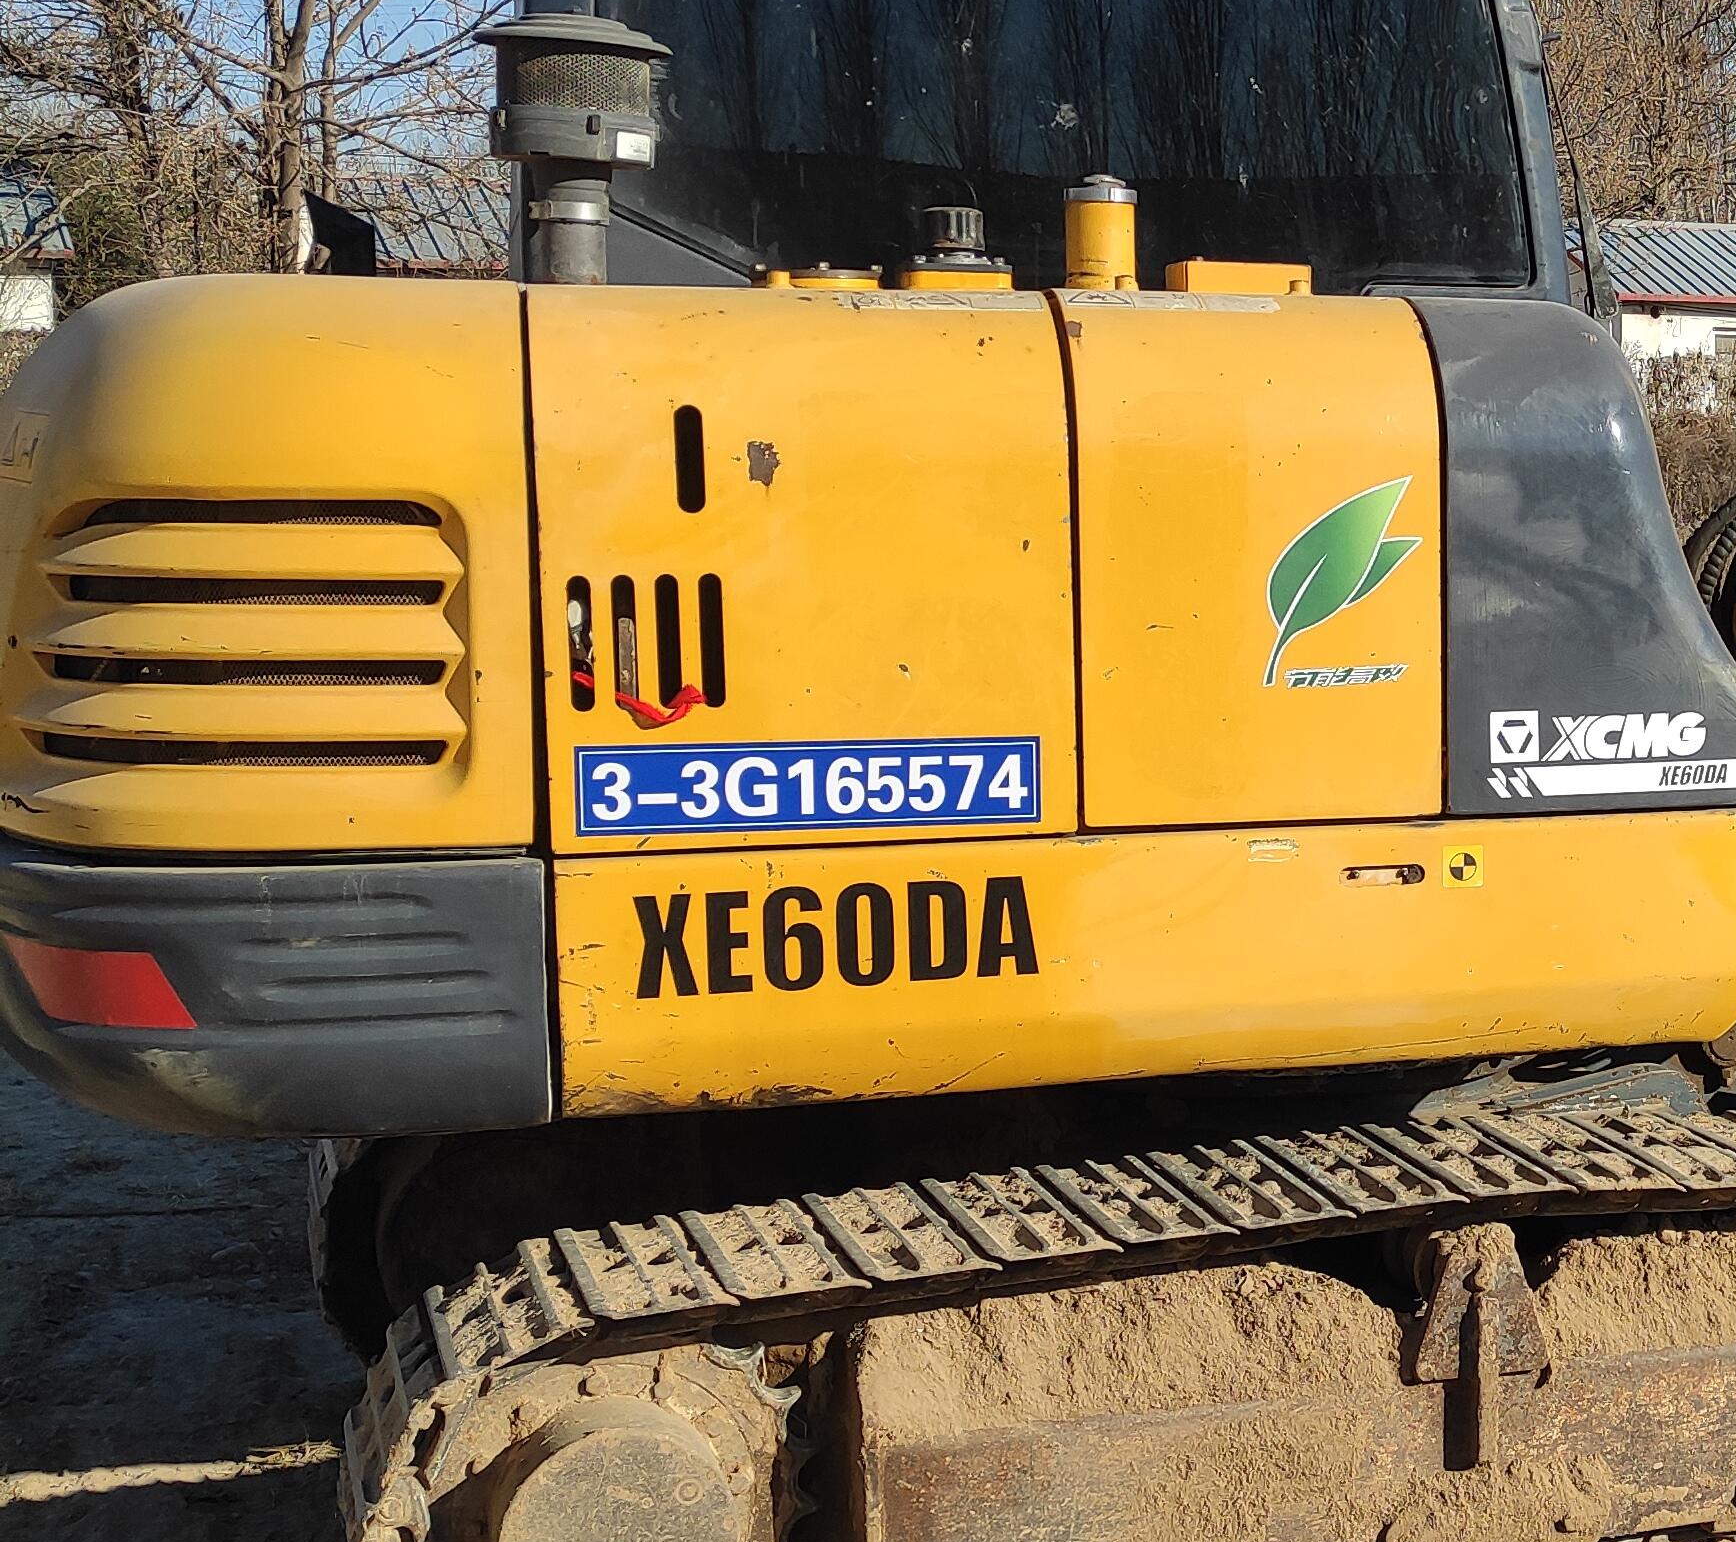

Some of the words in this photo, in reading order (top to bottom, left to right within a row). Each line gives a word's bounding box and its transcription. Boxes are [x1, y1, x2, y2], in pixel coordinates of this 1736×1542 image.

[1540, 711, 1707, 762] XCMG
[591, 754, 1029, 821] 3-3G165574
[1658, 763, 1729, 787] XE60DA
[632, 875, 1040, 1000] XE60DA
